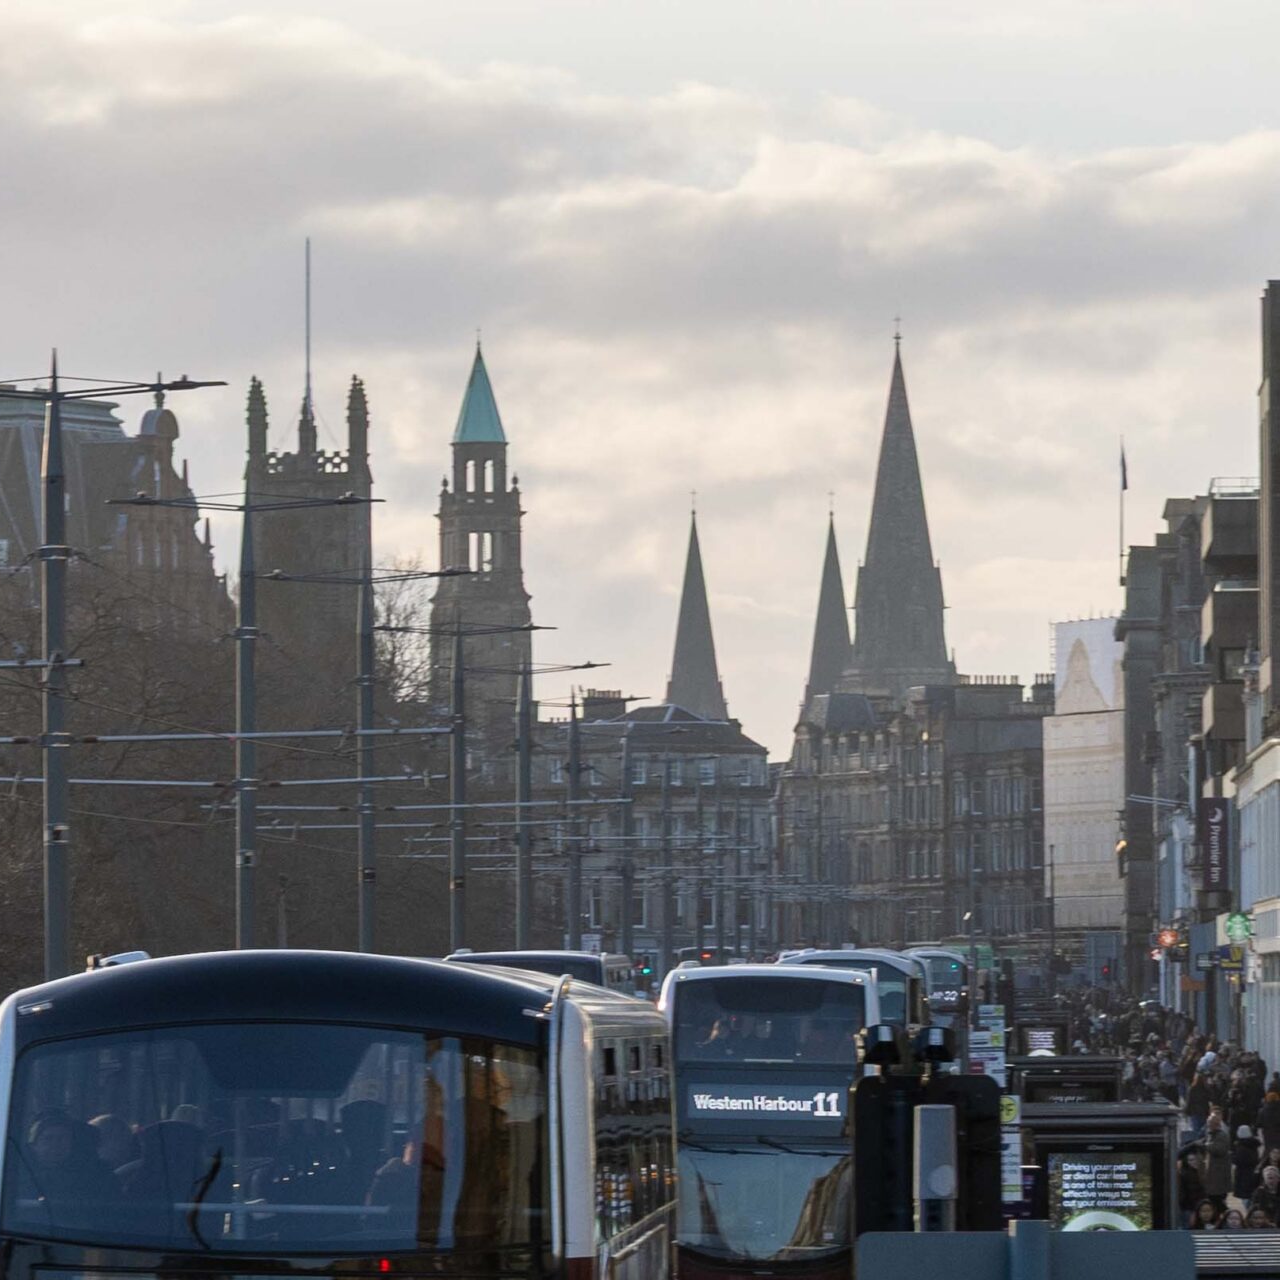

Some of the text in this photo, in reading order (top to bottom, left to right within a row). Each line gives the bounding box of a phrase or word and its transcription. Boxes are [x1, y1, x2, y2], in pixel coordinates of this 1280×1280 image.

[1209, 825, 1222, 883] Premier Inn
[693, 1092, 842, 1117] Western Harbour 11
[1062, 1163, 1090, 1173] Driving
[1113, 1163, 1137, 1173] petrol
[1073, 1172, 1096, 1180] diesel
[1062, 1190, 1097, 1198] effective
[1121, 1190, 1131, 1198] to
